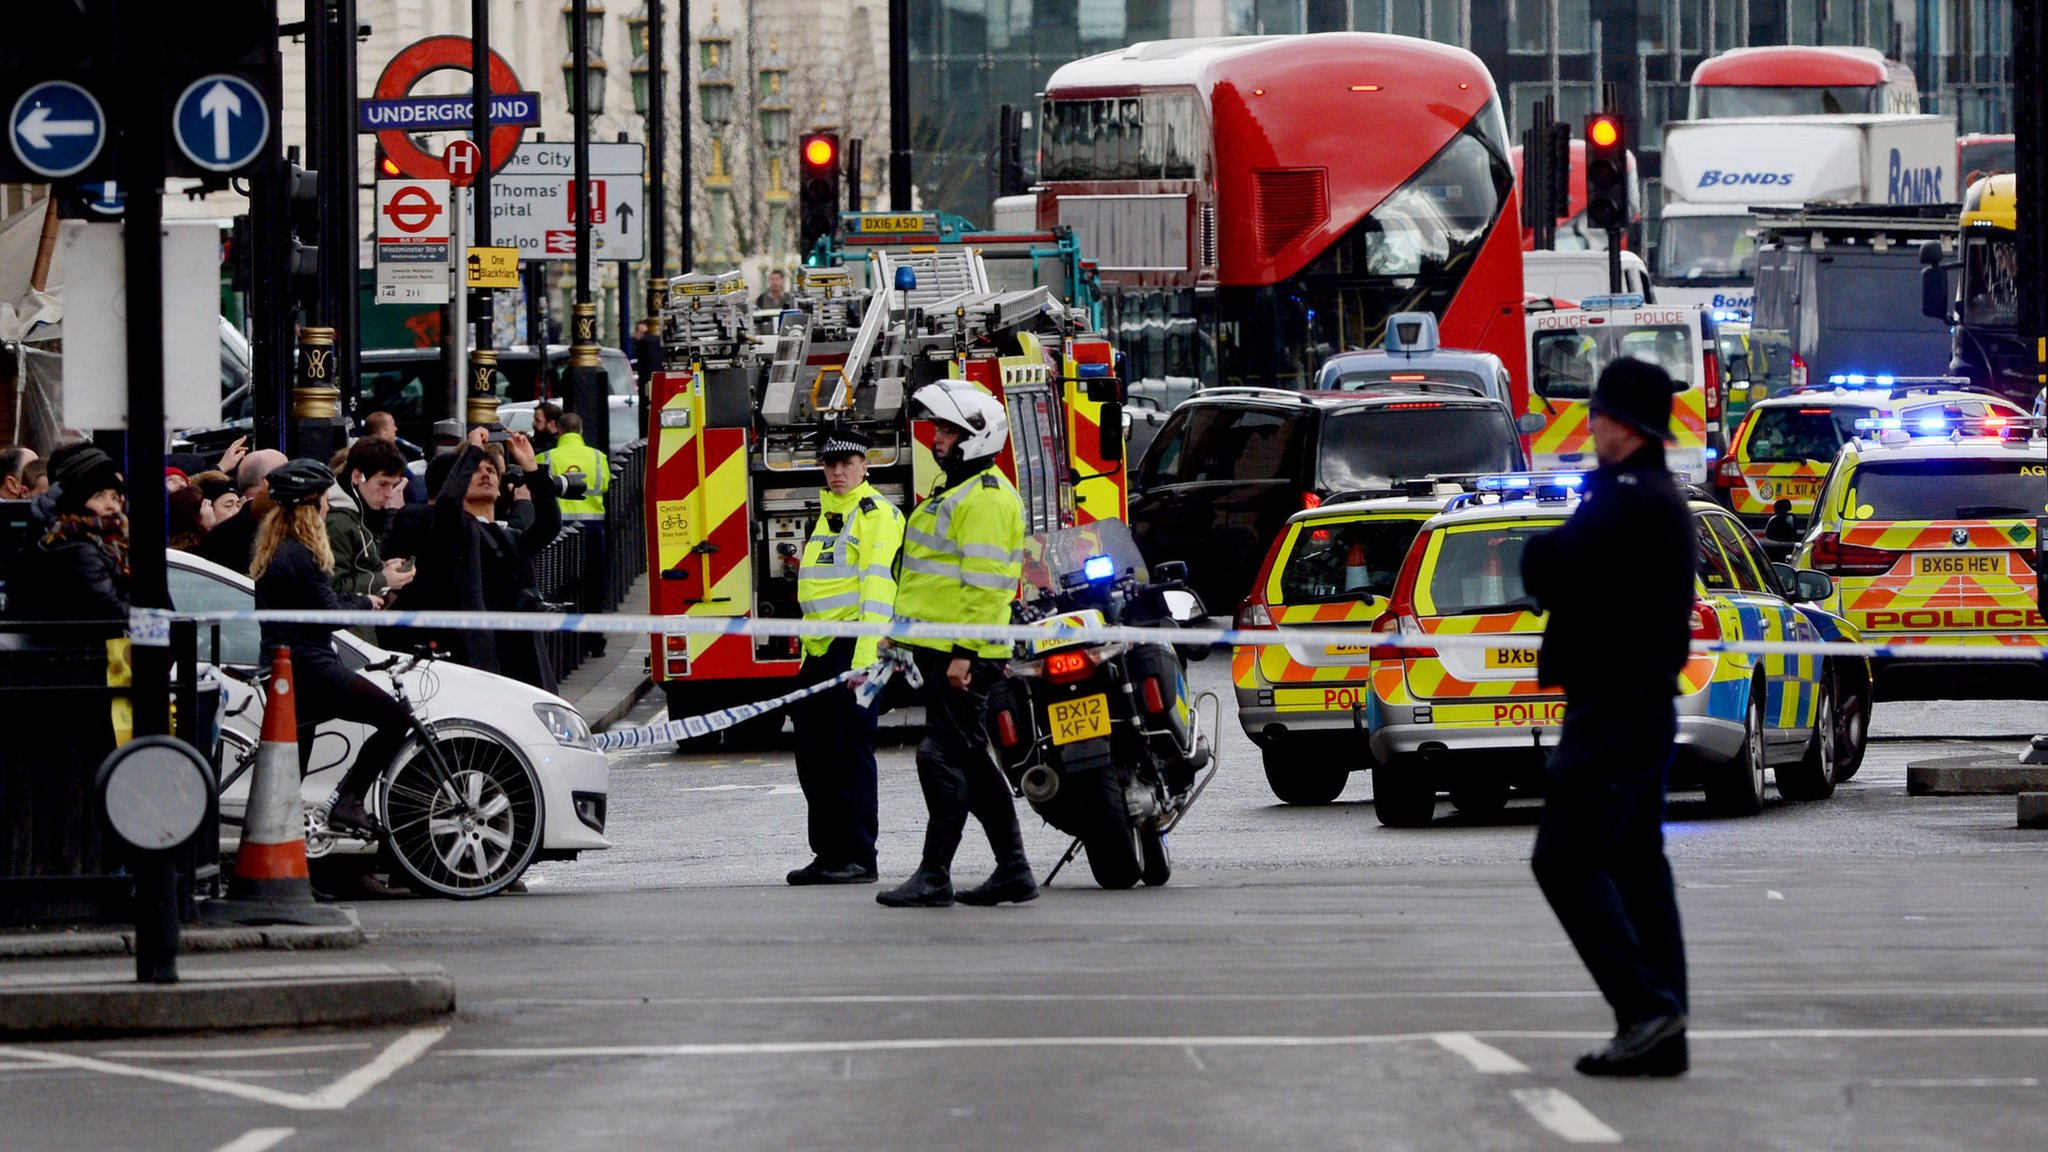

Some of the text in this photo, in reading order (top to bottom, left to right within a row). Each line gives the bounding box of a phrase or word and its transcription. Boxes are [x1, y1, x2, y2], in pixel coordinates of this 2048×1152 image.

[449, 146, 473, 174] H
[537, 151, 572, 171] City
[1697, 170, 1795, 188] BONDS
[1888, 147, 1943, 204] BONDS
[492, 183, 562, 197] Thomas'
[865, 218, 891, 229] DX16
[491, 255, 505, 265] One
[382, 289, 420, 297] 148 211
[1712, 294, 1755, 309] BON
[1538, 315, 1588, 328] POLICE
[1634, 312, 1684, 324] POLICE
[2020, 465, 2047, 477] AG
[660, 505, 687, 513] Cyclists
[1921, 557, 1999, 573] BX66 HEV
[1866, 609, 2047, 629] POLICE
[1498, 647, 1540, 664] BX6
[1324, 688, 1366, 710] POL
[1056, 698, 1101, 722] BX12
[1494, 703, 1567, 726] POLIC
[1061, 716, 1100, 739] KFV
